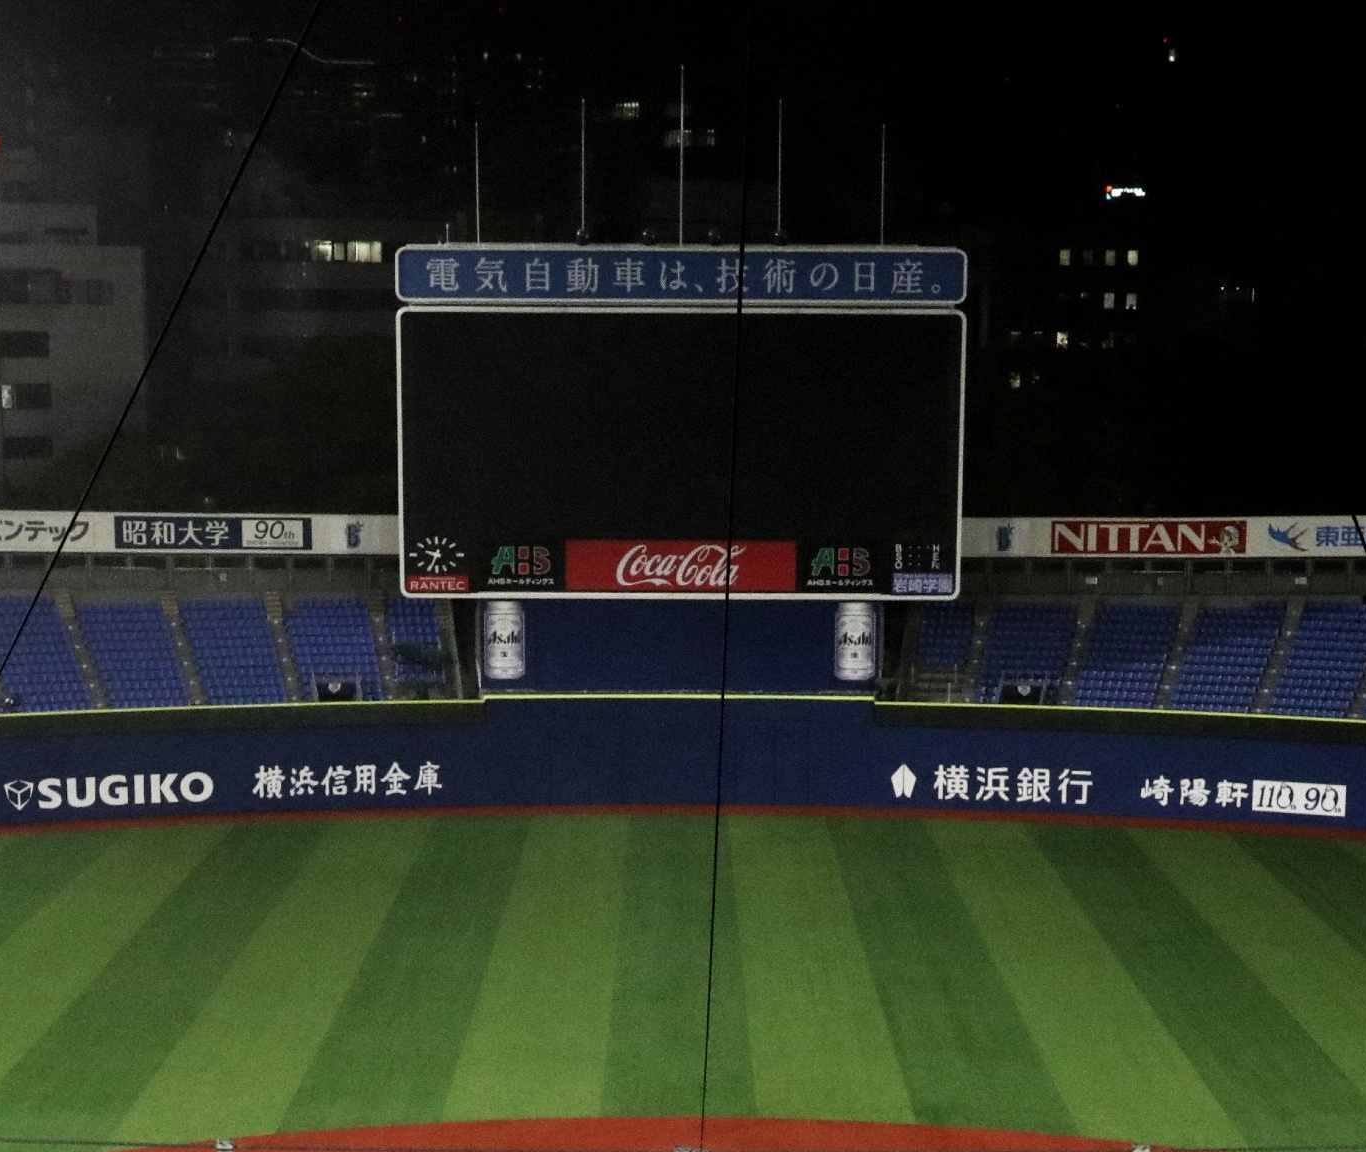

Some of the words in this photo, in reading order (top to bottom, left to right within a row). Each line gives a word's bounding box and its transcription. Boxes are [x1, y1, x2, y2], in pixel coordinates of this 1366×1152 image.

[426, 257, 942, 295] 電気自動車は、技術の日産。
[122, 521, 229, 546] 昭和大学
[1054, 524, 1207, 553] NITTAN
[616, 544, 747, 587] Coca-Cola
[410, 581, 465, 590] RANTEC
[39, 771, 213, 808] SUGIKO
[253, 761, 442, 798] 横浜信用金庫
[933, 764, 1093, 804] 横浜銀行
[1141, 778, 1249, 807] 崎陽軒
